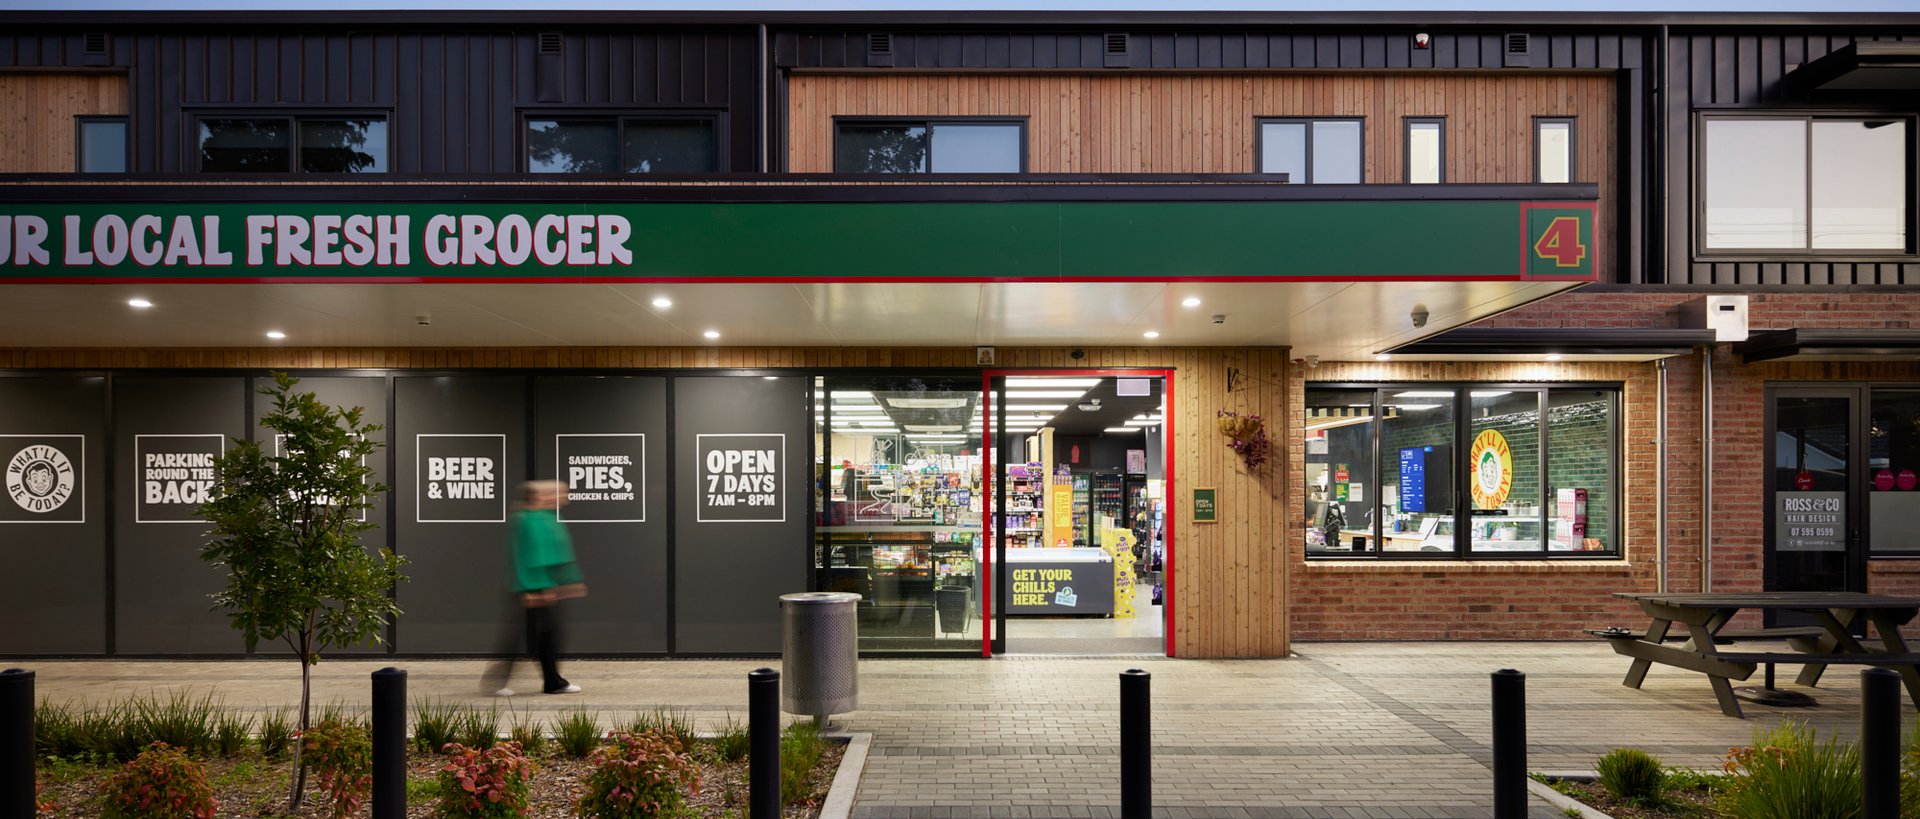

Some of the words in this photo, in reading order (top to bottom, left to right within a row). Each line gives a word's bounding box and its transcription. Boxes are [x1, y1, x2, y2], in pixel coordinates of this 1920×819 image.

[0, 214, 50, 266] R
[63, 214, 233, 266] LOCAL
[246, 214, 411, 266] FRESH
[423, 214, 633, 266] GROCER
[1534, 216, 1585, 267] 4
[10, 447, 57, 474] WHAT'LL
[57, 461, 71, 474] IT
[145, 453, 214, 467] PARKING
[568, 456, 633, 466] SANDWICHES,
[1471, 432, 1496, 472] WHAT'LL
[1497, 440, 1508, 457] IT
[428, 457, 494, 481] BEER
[707, 450, 775, 474] OPEN
[145, 468, 189, 480] ROUND
[190, 468, 214, 480] THE
[569, 466, 633, 492] PIES,
[145, 480, 215, 504] BACK
[428, 482, 442, 499] &
[447, 482, 495, 499] WINE
[707, 474, 720, 493] 7
[724, 474, 776, 493] DAYS
[10, 483, 25, 501] BE
[27, 483, 70, 511] TODAY?
[568, 492, 602, 501] CHICKEN
[603, 492, 610, 501] &
[611, 492, 634, 501] CHIPS
[707, 494, 735, 506] 7AM
[747, 494, 775, 506] 8PM
[1473, 484, 1483, 504] BE
[1787, 515, 1805, 523] HAIR
[1808, 515, 1837, 523] DESIGN
[1791, 527, 1799, 537] 07
[1801, 527, 1814, 537] 595
[1816, 527, 1834, 537] 0599
[1012, 569, 1037, 581] GET
[1038, 569, 1072, 581] YOUR
[1012, 581, 1056, 593] CHILLS
[1012, 594, 1049, 606] HERE.
